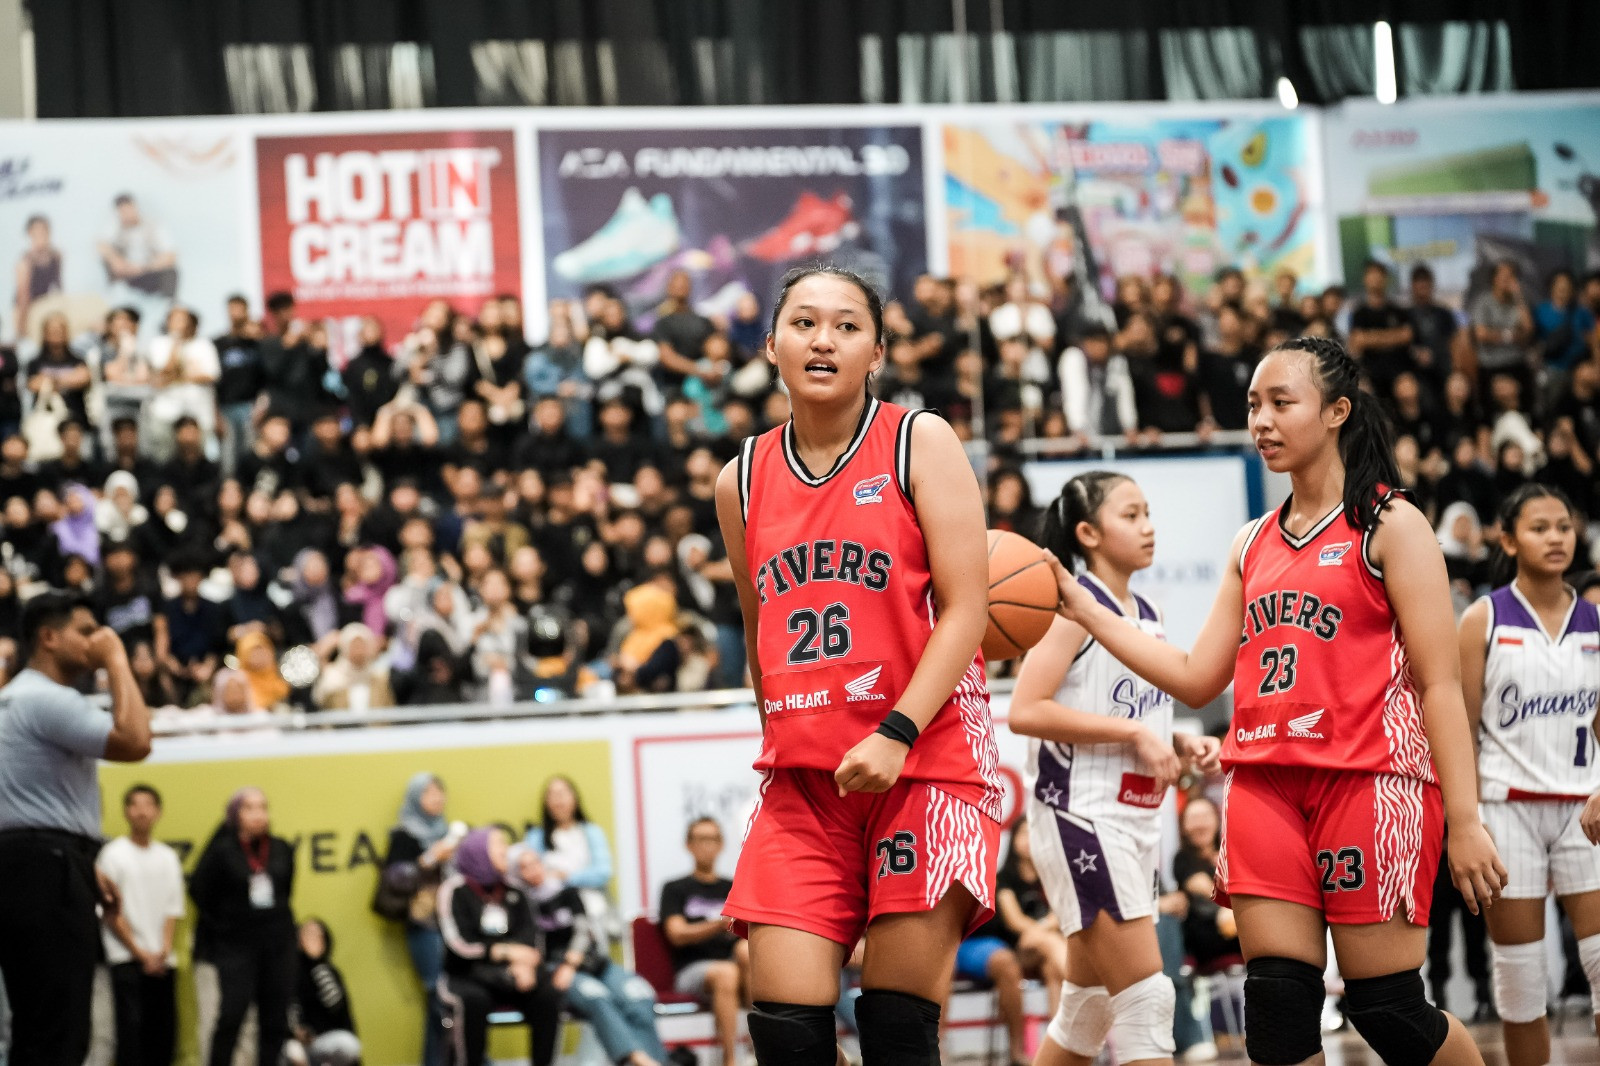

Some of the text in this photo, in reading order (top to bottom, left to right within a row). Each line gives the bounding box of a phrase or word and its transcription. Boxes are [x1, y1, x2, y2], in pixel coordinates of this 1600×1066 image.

[290, 220, 495, 283] CREAM
[756, 539, 893, 606] FIVERS
[787, 602, 852, 666] 26
[1240, 589, 1343, 647] IVERS
[1258, 644, 1299, 697] 23
[764, 689, 831, 715] One HEART.
[846, 693, 886, 703] HONDA
[1236, 728, 1255, 743] One
[1287, 731, 1325, 739] HONDA
[876, 830, 918, 884] 26
[1317, 846, 1366, 893] 23
